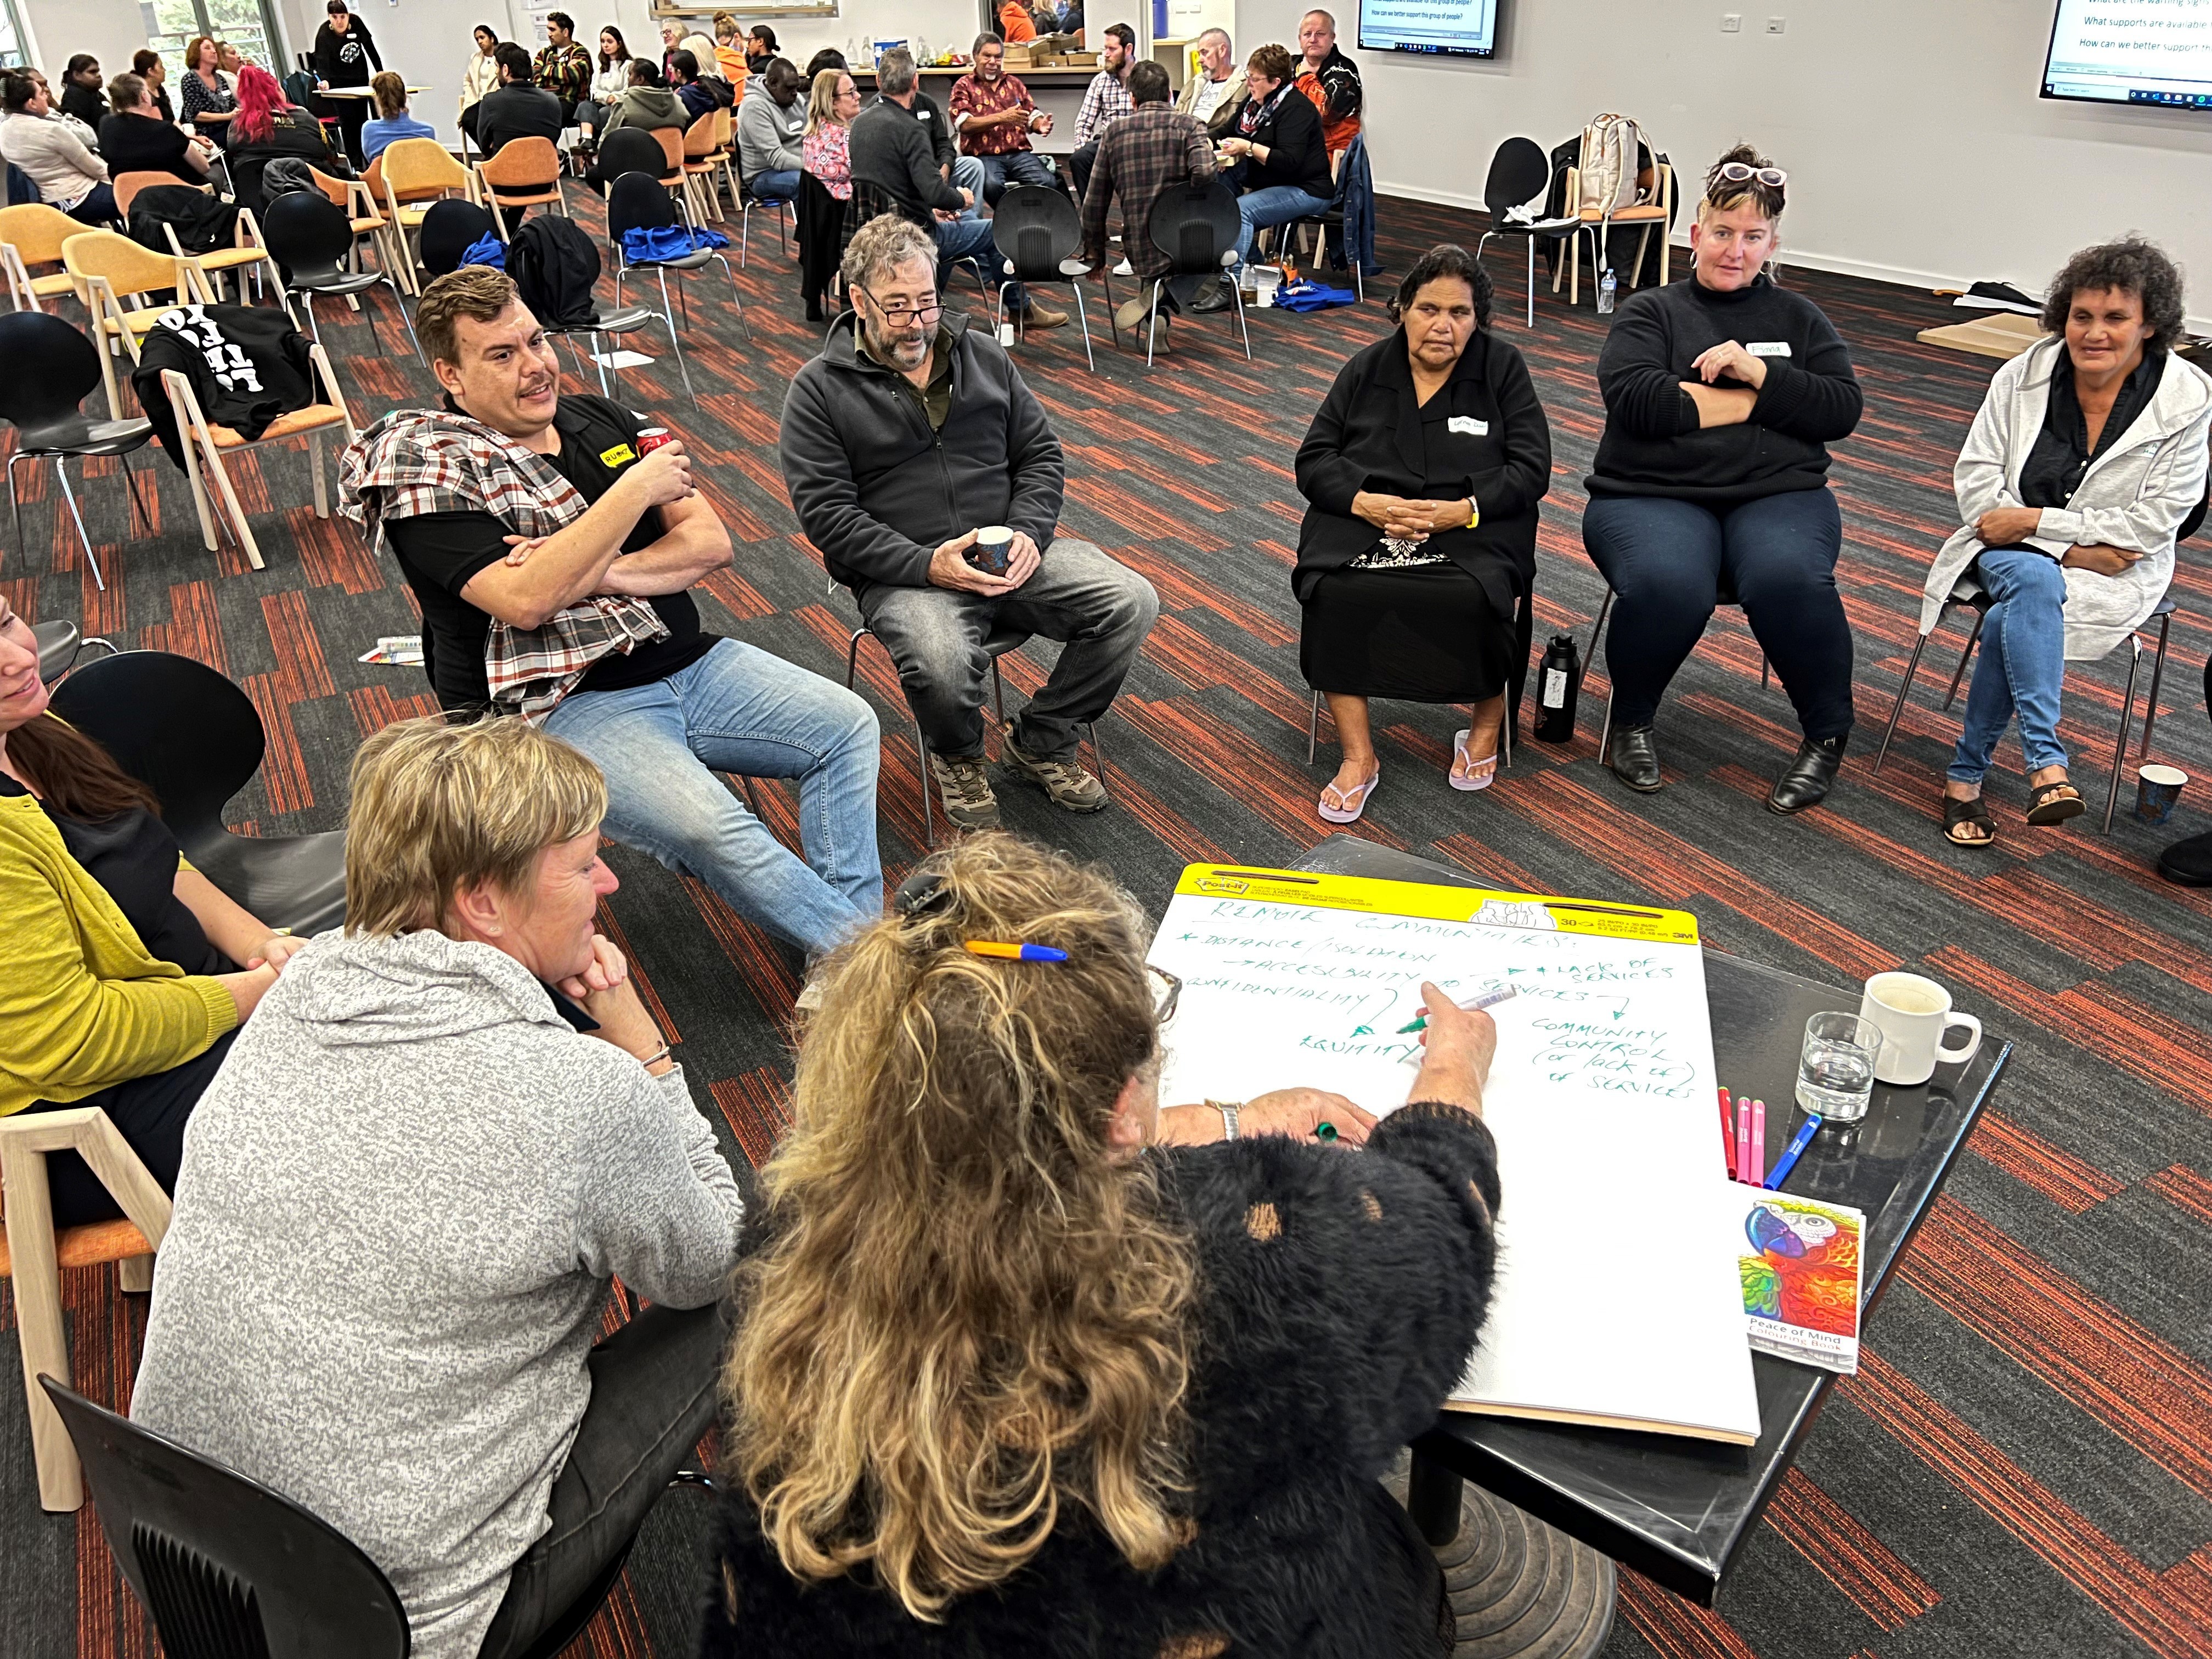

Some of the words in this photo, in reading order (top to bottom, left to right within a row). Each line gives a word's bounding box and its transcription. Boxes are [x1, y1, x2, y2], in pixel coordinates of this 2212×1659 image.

[2084, 16, 2107, 26] What
[2109, 18, 2147, 28] supports
[2166, 20, 2207, 29] available
[2079, 38, 2098, 47] How
[2134, 41, 2160, 50] better
[2163, 43, 2198, 53] support
[1202, 880, 1244, 890] Post-it
[1211, 901, 1325, 923] REMOTE
[1629, 957, 1659, 969] OF
[1572, 967, 1674, 984] SERVICES
[1532, 1018, 1668, 1046] COMMUNITY
[1550, 1034, 1673, 1061] CONTROL
[1587, 1075, 1696, 1099] SERVICES
[1748, 1325, 1807, 1346] Colouring
[1812, 1340, 1842, 1351] Book
[1750, 1317, 1787, 1333] Peace
[1791, 1328, 1804, 1337] of
[1808, 1331, 1841, 1344] Mind
